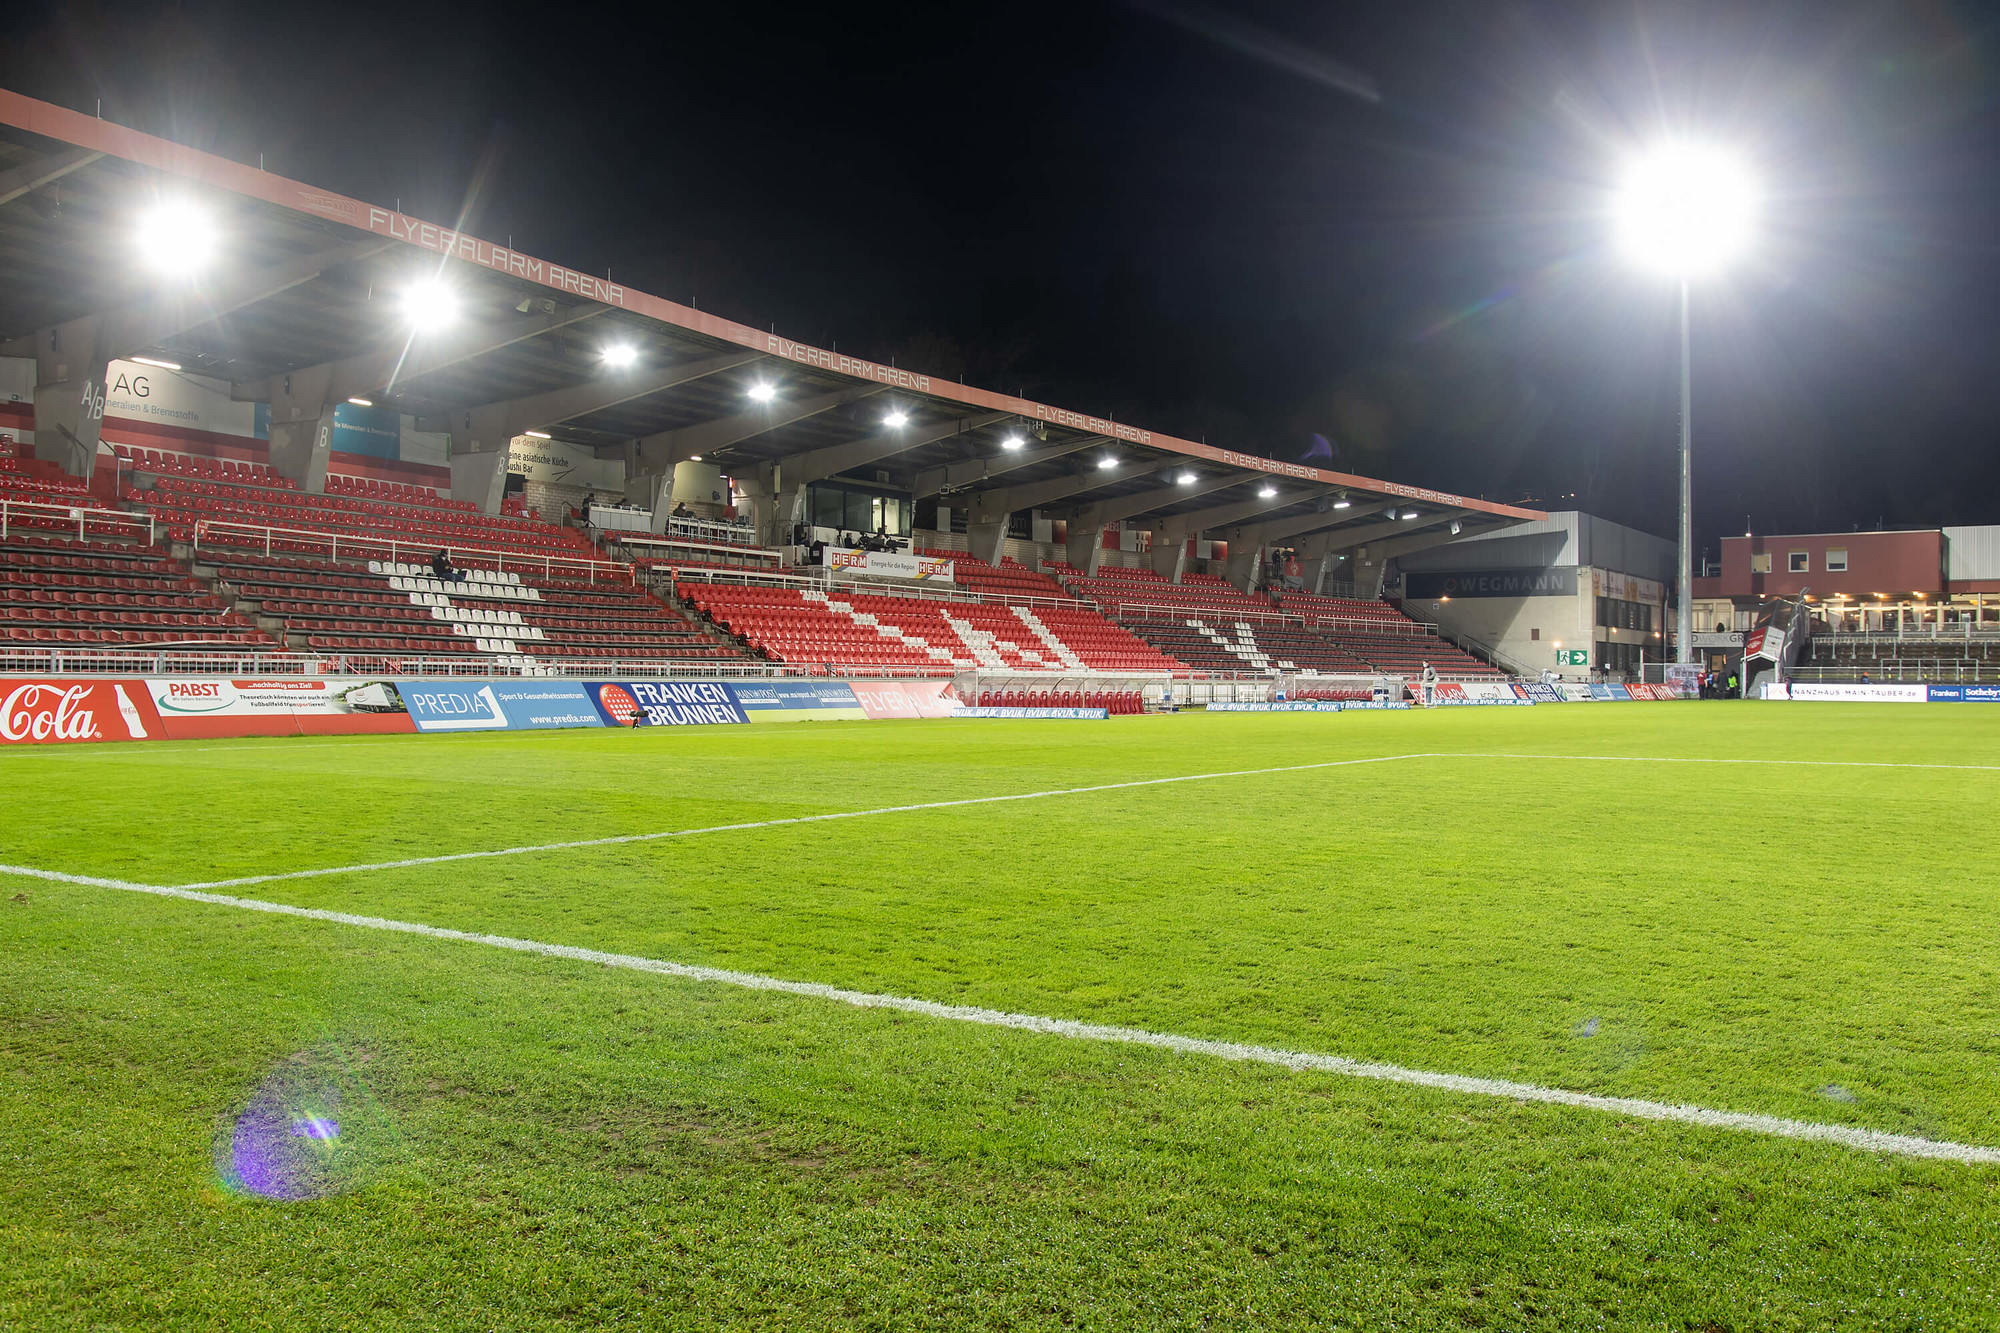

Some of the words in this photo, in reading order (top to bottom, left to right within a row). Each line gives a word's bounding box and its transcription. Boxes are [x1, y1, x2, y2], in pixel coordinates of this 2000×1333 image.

[370, 207, 542, 281] FLYERALARM
[550, 266, 623, 305] ARENA
[768, 336, 873, 380] FLYERALARM
[877, 366, 930, 392] ARENA
[113, 373, 150, 398] AG
[81, 381, 105, 420] A/B
[151, 405, 200, 422] Brennstoffe
[1036, 405, 1113, 435] FLYERALARM
[1116, 425, 1151, 444] ARENA
[320, 426, 329, 448] B
[497, 456, 505, 475] B
[507, 462, 522, 472] ushi
[522, 452, 551, 465] asiatische
[1224, 451, 1284, 474] FLYERALARM
[1286, 464, 1318, 480] ARENA
[1384, 482, 1437, 503] FLYERALARM
[1437, 491, 1463, 507] ARENA
[832, 552, 868, 568] HERM
[871, 559, 887, 569] Energie
[901, 561, 915, 571] Region
[918, 561, 950, 576] HERM
[1460, 575, 1563, 592] WEGMANN
[169, 683, 219, 697] PABST
[499, 692, 516, 701] Sport
[516, 692, 523, 700] &
[524, 692, 584, 700] Gesundheitszentrum
[630, 683, 731, 704] FRANKEN
[1930, 689, 1960, 697] Franken
[412, 694, 491, 714] PREDIA
[530, 714, 597, 725] www.predia.com
[642, 704, 742, 726] BRUNNEN
